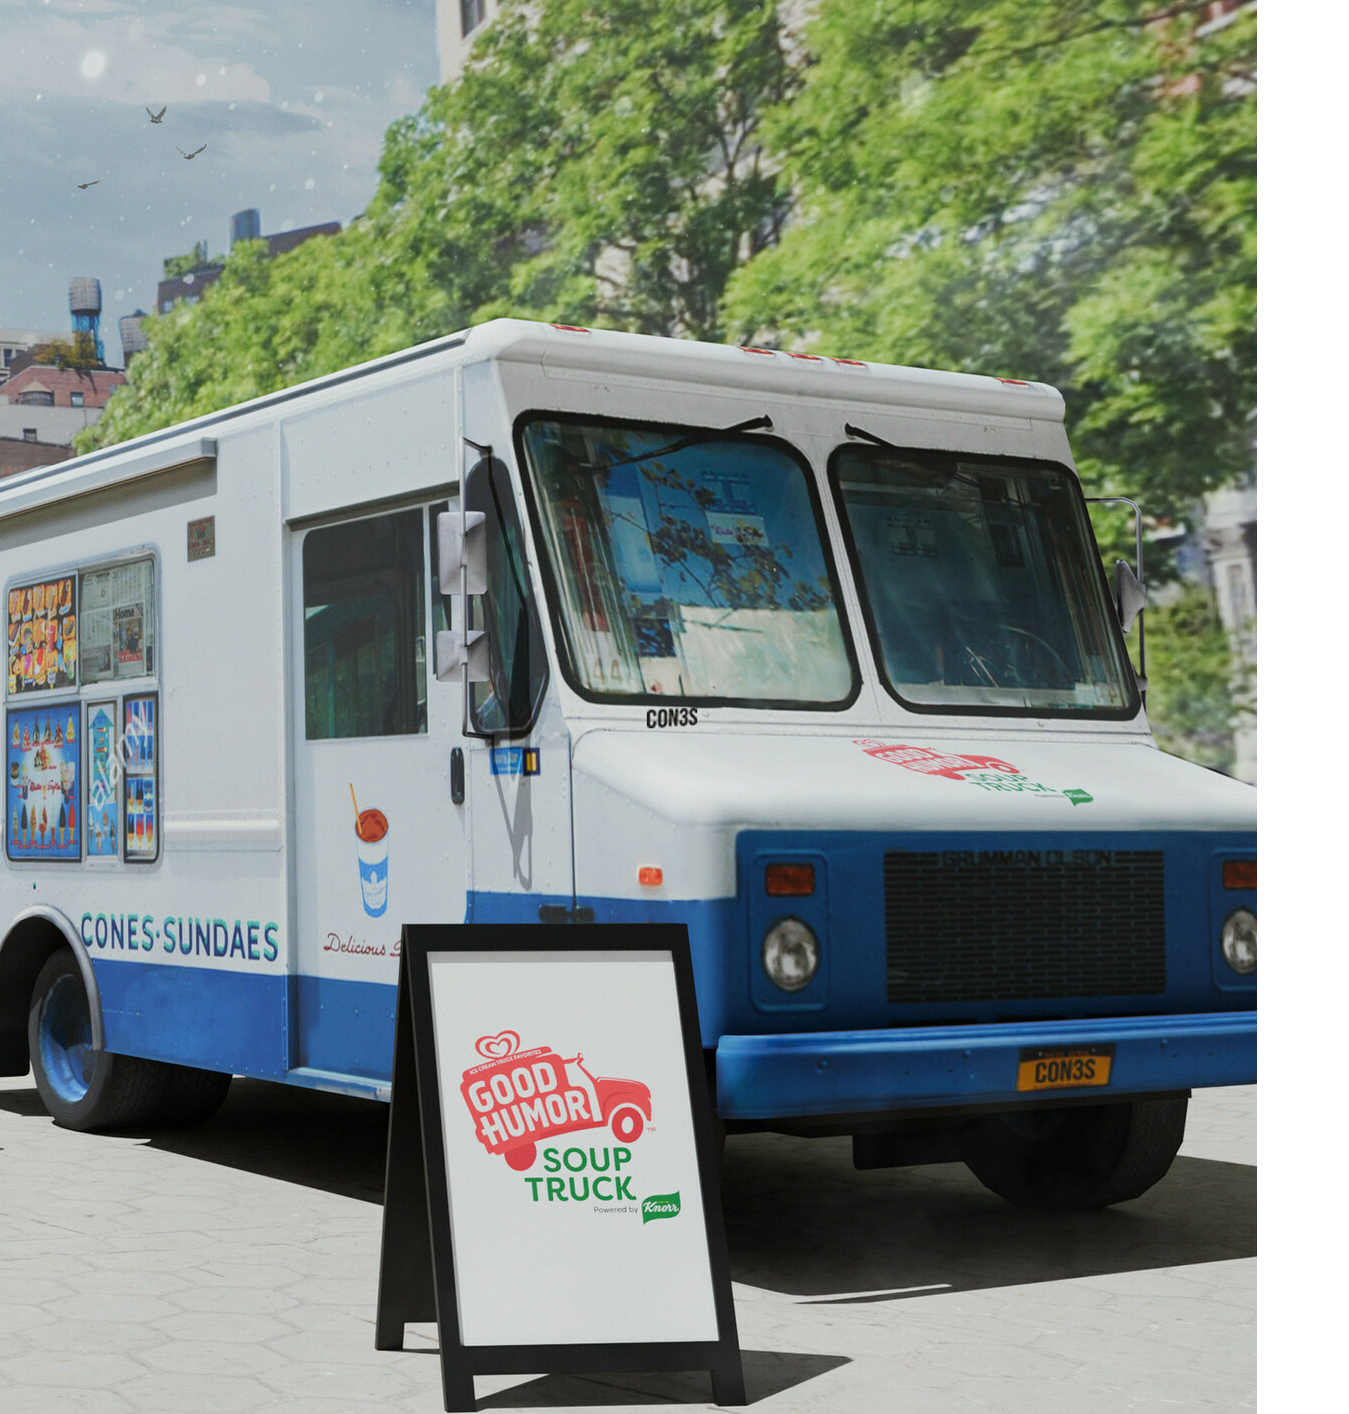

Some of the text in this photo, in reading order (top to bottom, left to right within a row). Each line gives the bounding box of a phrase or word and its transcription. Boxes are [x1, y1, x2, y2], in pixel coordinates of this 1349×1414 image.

[646, 707, 698, 729] CON3S
[965, 773, 1028, 782] SOUP
[968, 782, 1058, 792] TRUCK
[942, 850, 1113, 866] GRUMMAN OLSON
[323, 932, 386, 956] Delicious
[478, 1060, 497, 1073] CREAM
[1035, 1058, 1096, 1084] CON3S
[468, 1062, 558, 1113] GOOD
[480, 1090, 591, 1146] HUMOR
[543, 1147, 632, 1172] SOUP
[524, 1176, 637, 1202] TRUCK
[593, 1206, 639, 1214] Powered by
[643, 1201, 679, 1213] Knorr
